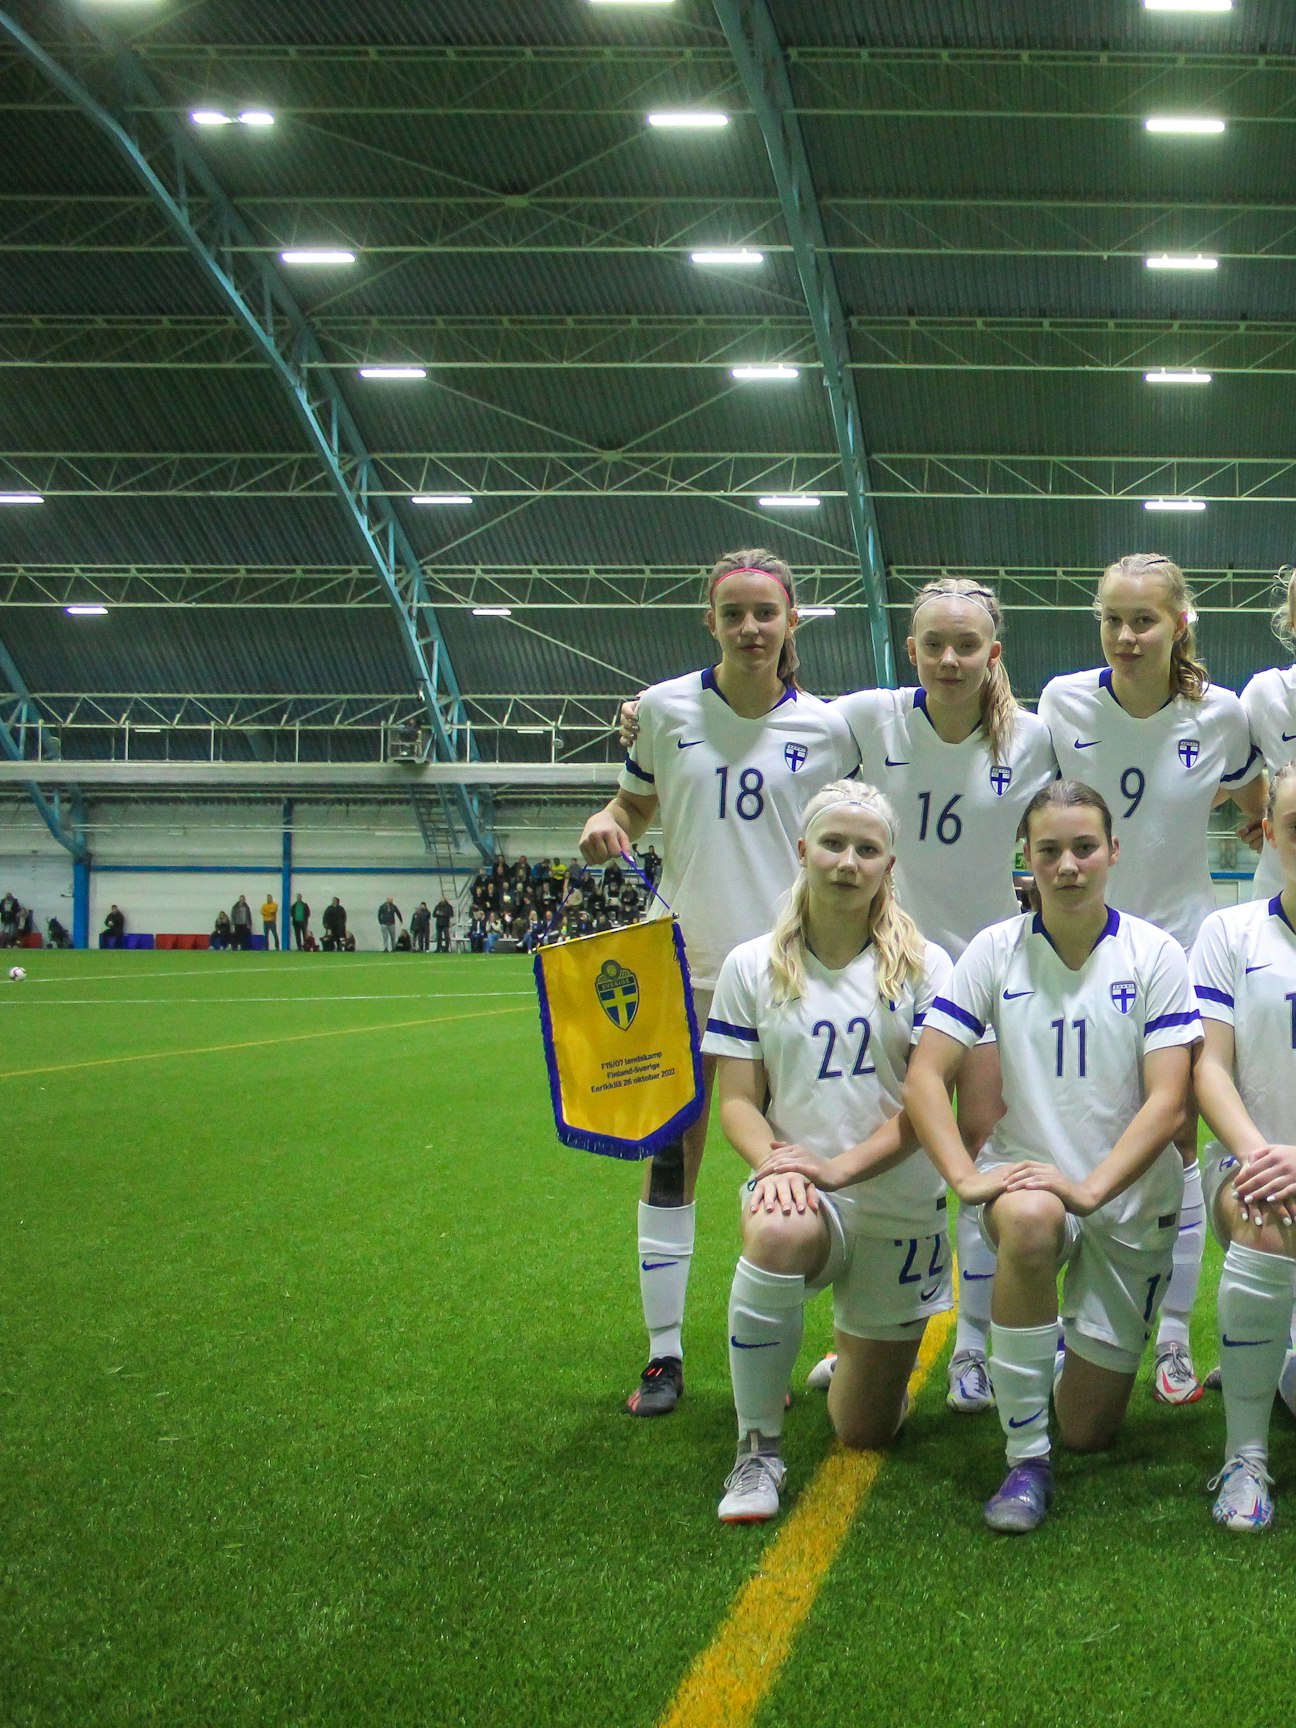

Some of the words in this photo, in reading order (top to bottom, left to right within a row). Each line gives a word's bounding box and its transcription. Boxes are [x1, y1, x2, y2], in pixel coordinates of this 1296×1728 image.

[715, 766, 764, 821] 18
[918, 791, 962, 845] 16
[1120, 767, 1146, 819] 9
[607, 1062, 660, 1079] Finland-Sverige
[624, 1051, 663, 1065] landskamp
[812, 1016, 874, 1080] 22
[1051, 1018, 1086, 1077] 11
[633, 1073, 660, 1084] oktober
[894, 1233, 944, 1285] 22
